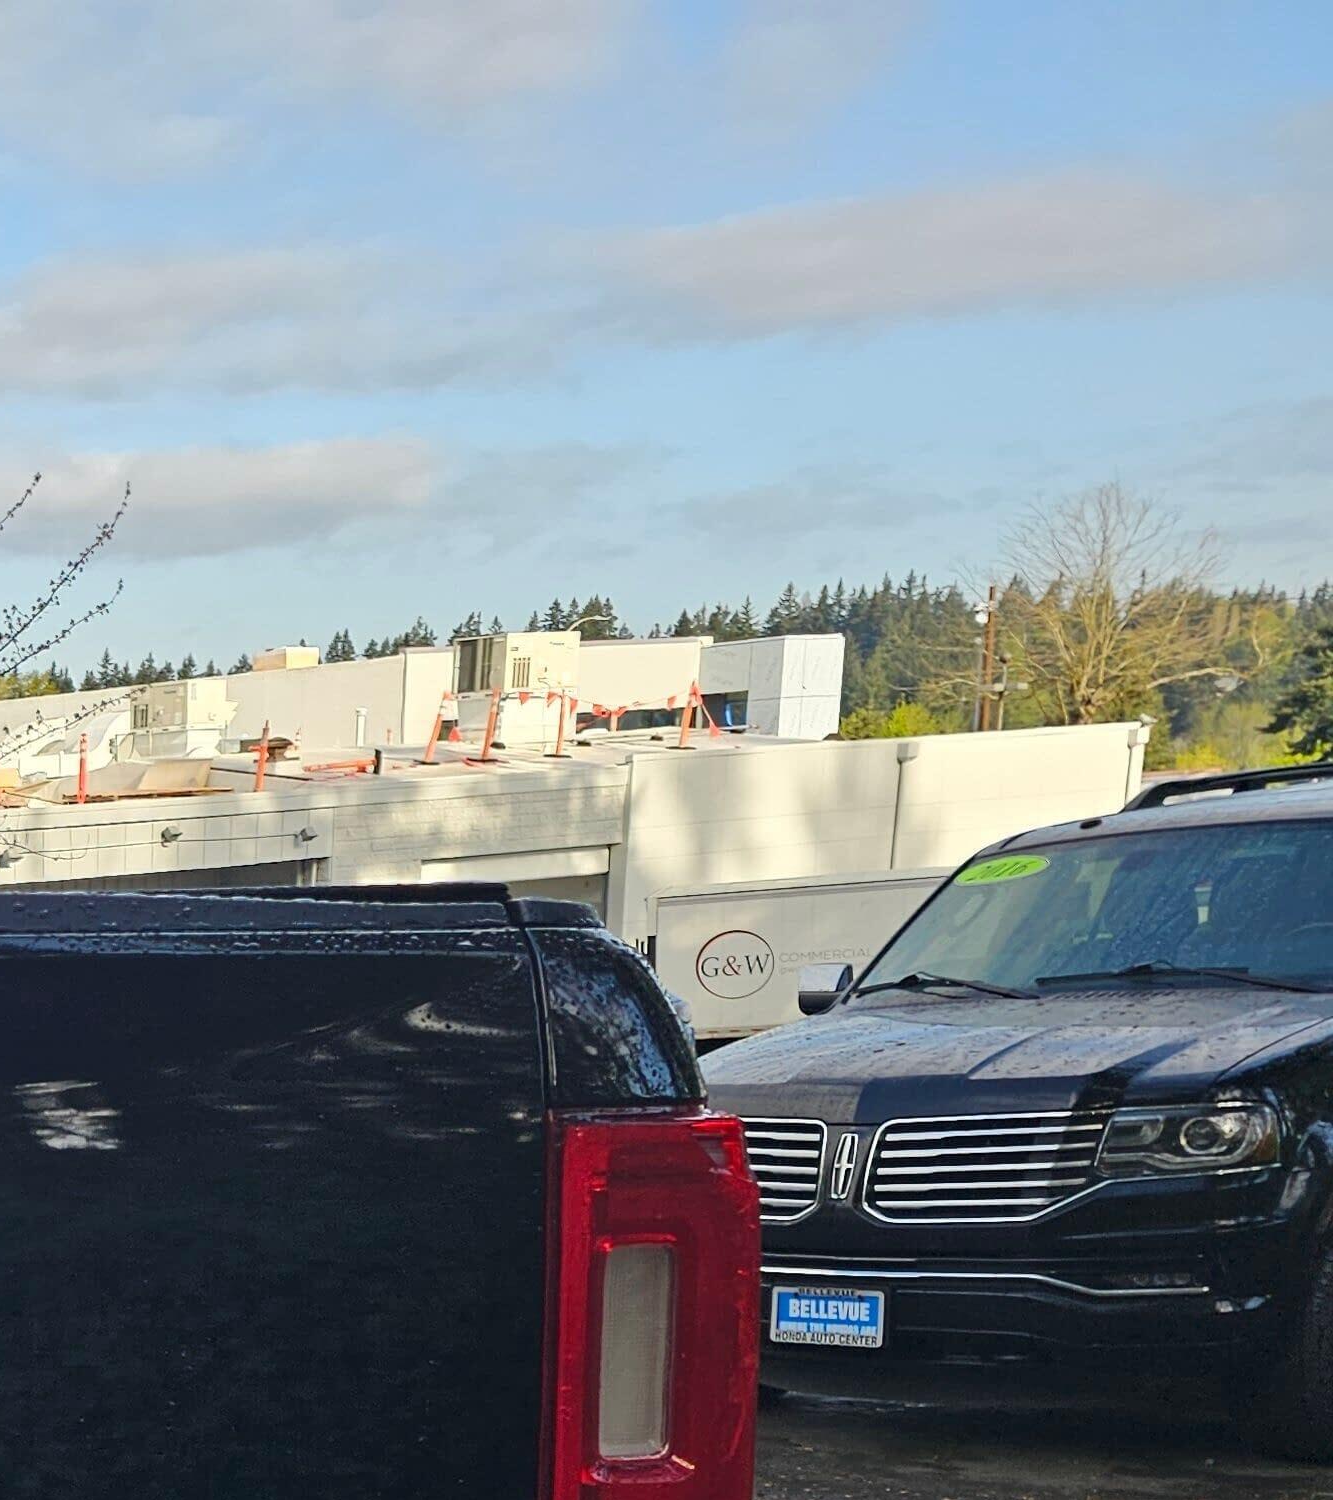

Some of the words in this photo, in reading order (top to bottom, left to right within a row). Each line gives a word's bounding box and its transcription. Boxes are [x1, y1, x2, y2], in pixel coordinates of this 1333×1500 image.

[701, 954, 770, 977] G&W
[778, 948, 872, 964] COMMERCIAL
[789, 1298, 870, 1321] BELLEVUE
[775, 1330, 807, 1341] HONDA
[810, 1333, 835, 1343] AUTO
[839, 1334, 877, 1346] CENTER
